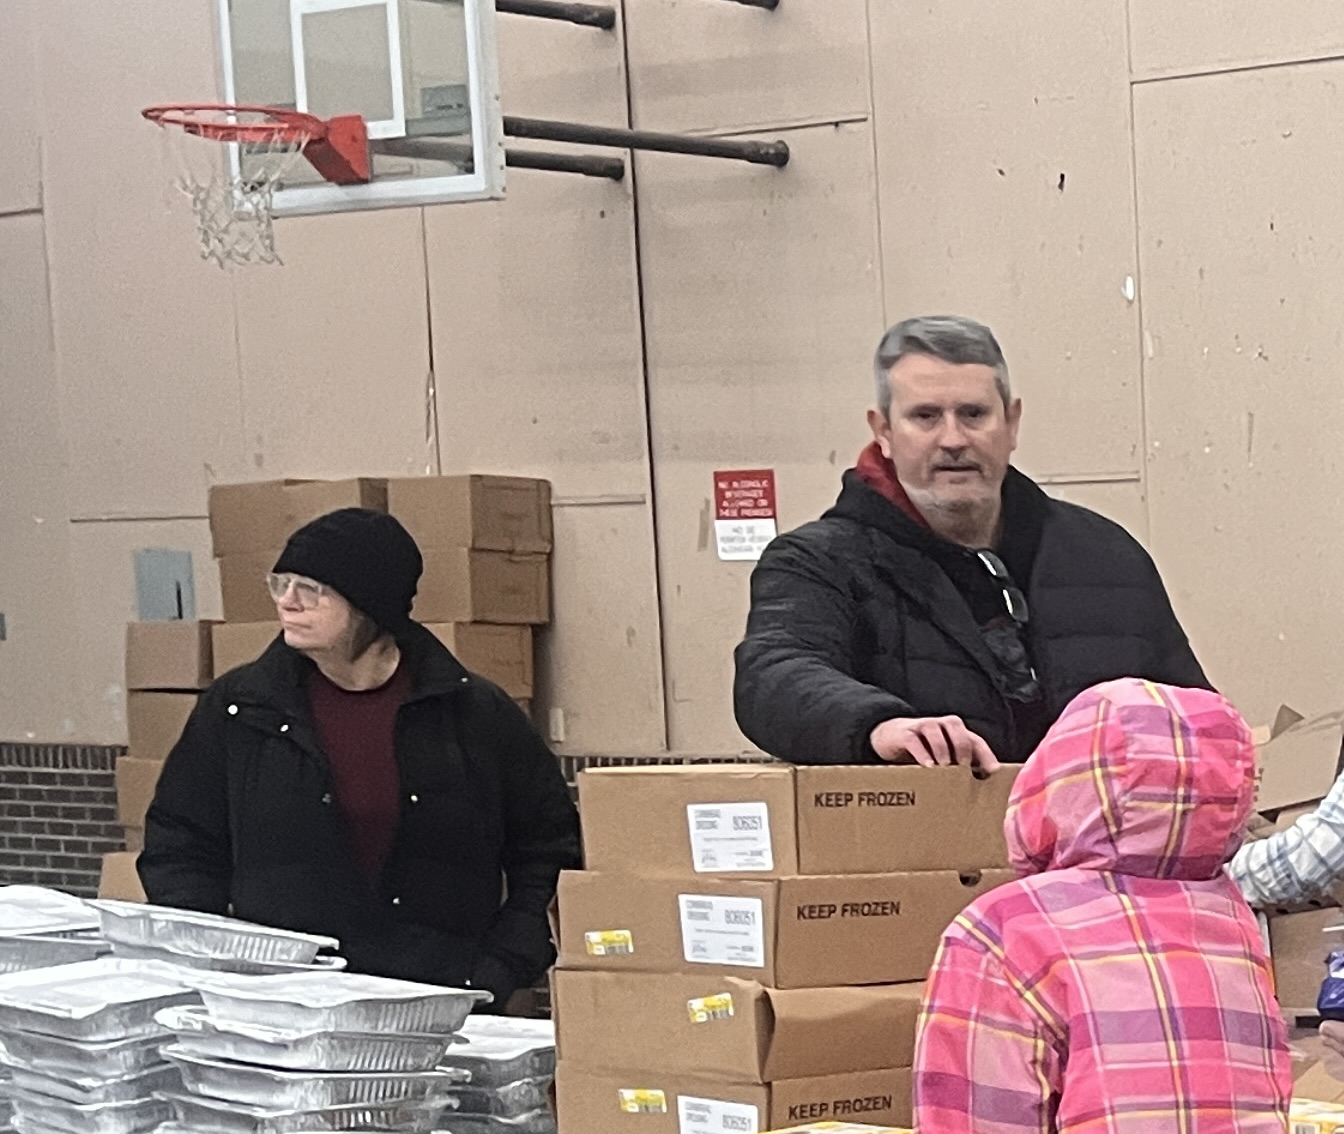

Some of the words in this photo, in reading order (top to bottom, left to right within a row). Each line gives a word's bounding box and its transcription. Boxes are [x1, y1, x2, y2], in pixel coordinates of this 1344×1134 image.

[814, 792, 853, 808] KEEP
[858, 791, 916, 807] FROZEN
[797, 903, 836, 920] KEEP
[841, 901, 900, 918] FROZEN
[788, 1103, 828, 1120] KEEP
[833, 1096, 892, 1116] FROZEN
